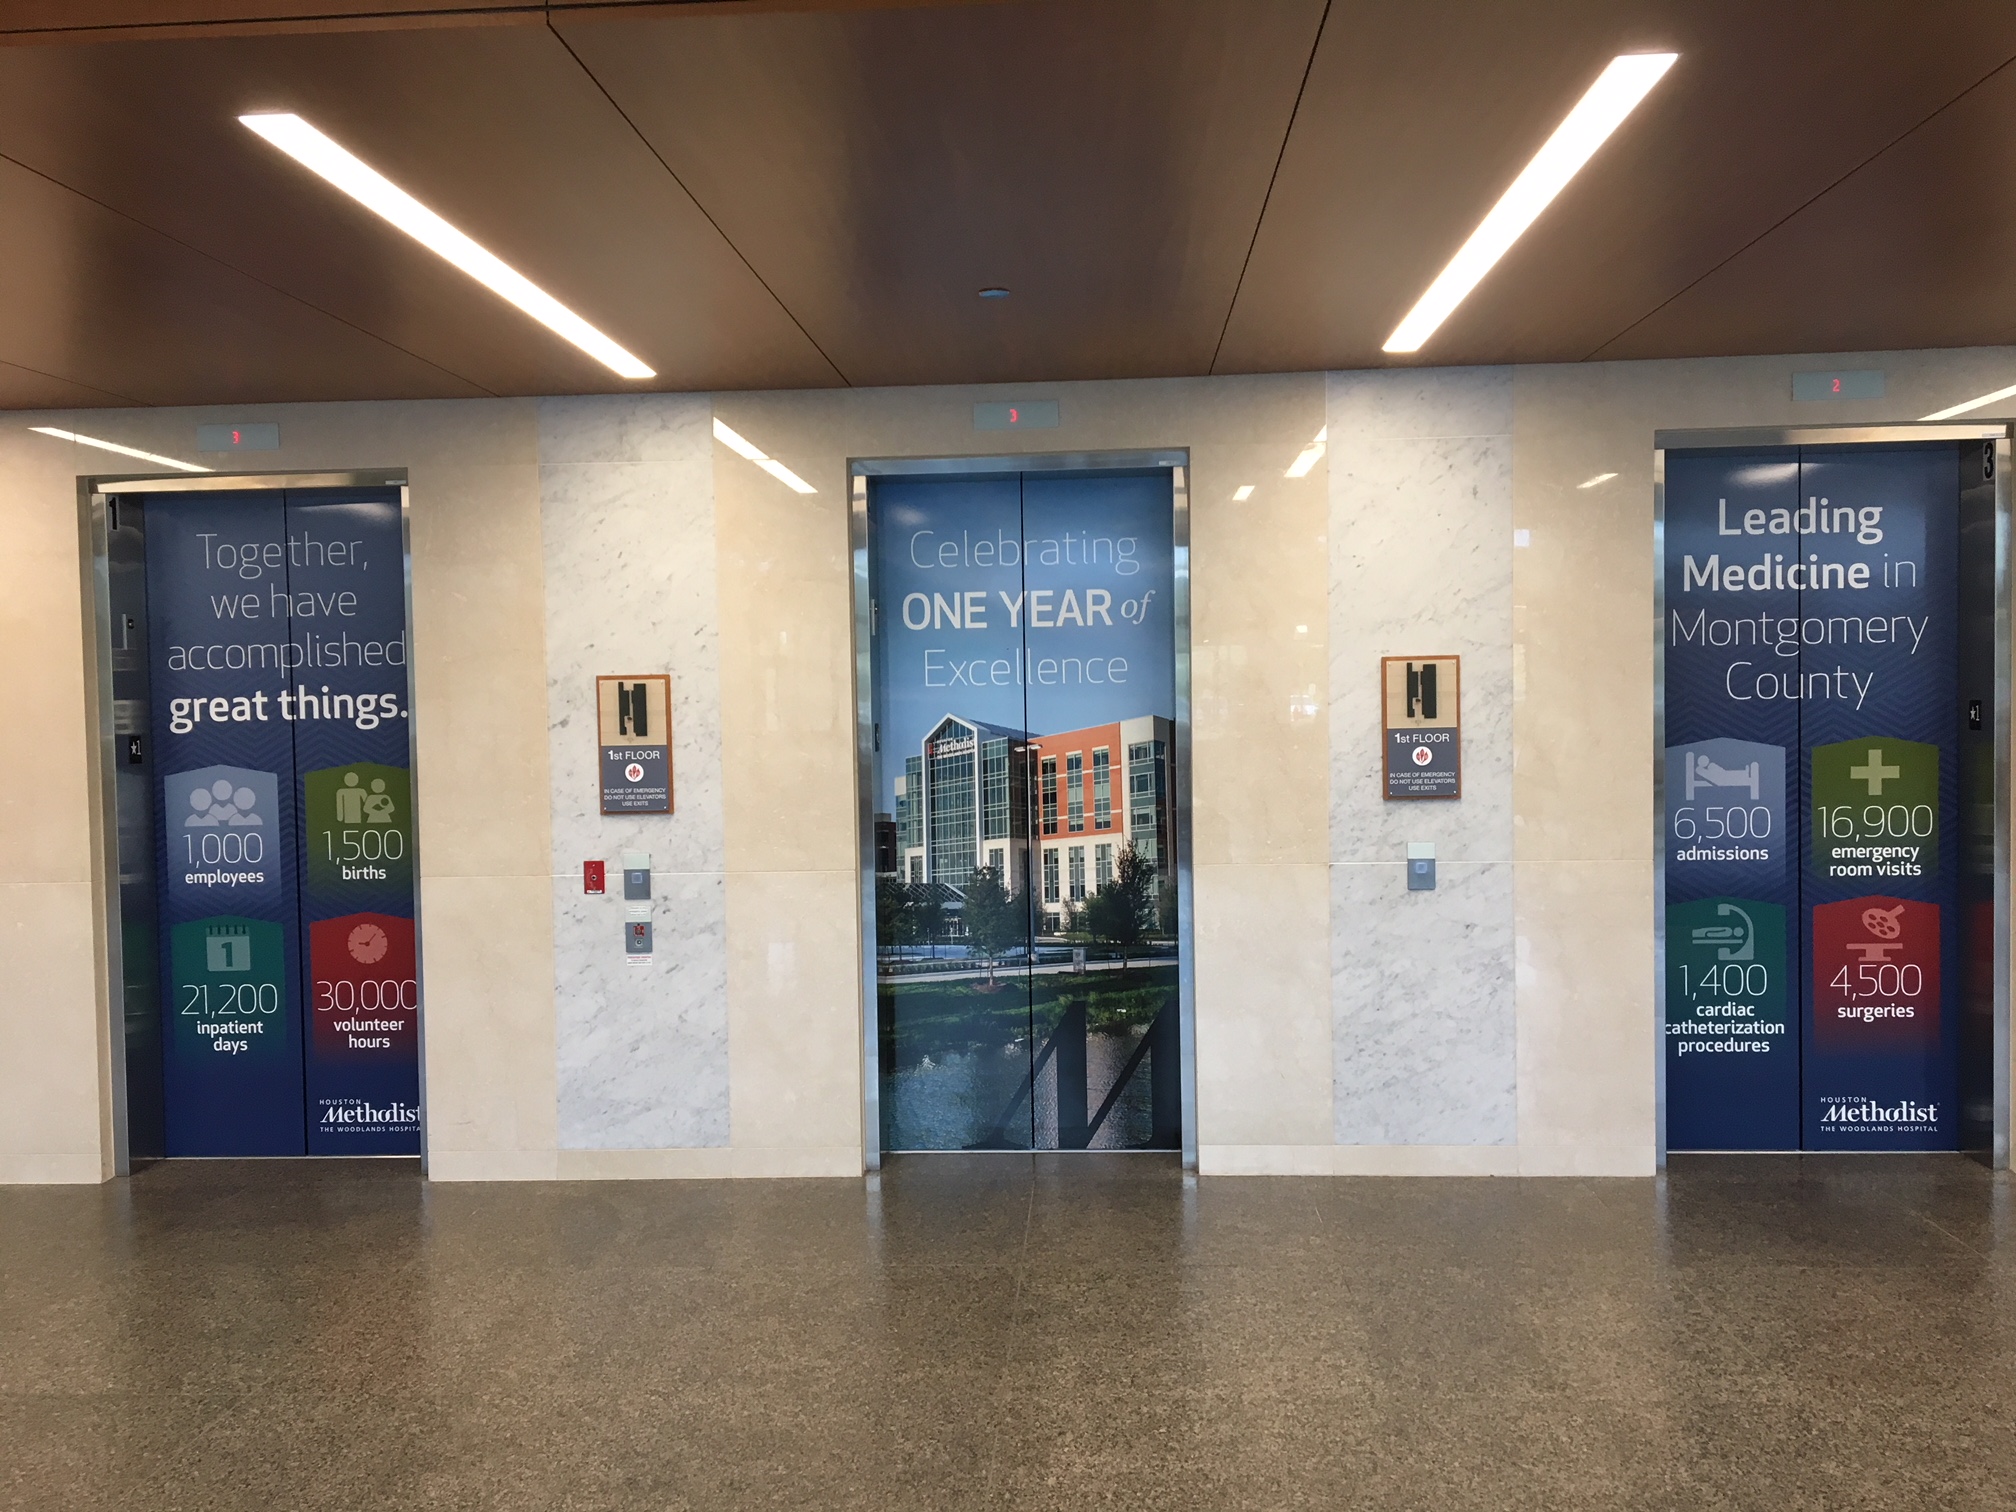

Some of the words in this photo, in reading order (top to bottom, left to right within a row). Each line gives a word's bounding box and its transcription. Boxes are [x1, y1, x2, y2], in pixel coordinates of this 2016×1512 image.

[1832, 378, 1841, 392] 2
[1010, 408, 1019, 423] 3
[231, 430, 240, 444] 3
[1984, 442, 1993, 479] 3
[109, 497, 118, 531] 1
[1718, 496, 1884, 545] Leading
[196, 531, 368, 580] Together,
[910, 529, 1141, 576] Celebrating
[1683, 553, 1870, 591] Medicine
[1883, 553, 1917, 588] in
[211, 594, 260, 619] we
[270, 583, 357, 617] have
[902, 591, 988, 631] ONE
[998, 589, 1113, 628] YEAR
[1120, 589, 1156, 625] of
[1671, 608, 1929, 657] Montgomery
[167, 630, 406, 679] accomplished
[924, 647, 1129, 688] Excellence
[1726, 661, 1874, 711] County
[169, 691, 269, 734] great
[277, 685, 408, 730] things.
[937, 736, 975, 754] Methodis
[1394, 732, 1410, 744] 1st
[1412, 733, 1450, 743] FLOOR
[608, 749, 623, 760] 1st
[625, 750, 660, 760] FLOOR
[1674, 806, 1771, 843] 6,500
[1817, 804, 1933, 842] 16,900
[183, 832, 263, 868] 1,000
[322, 829, 403, 865] 1,500
[1676, 847, 1769, 861] admissions
[1831, 845, 1920, 862] emergency
[185, 870, 265, 887] employees
[342, 865, 387, 881] births
[1829, 864, 1872, 877] room
[1876, 861, 1922, 876] visits
[221, 941, 233, 968] 1
[1679, 963, 1768, 1001] 1,400
[1829, 964, 1923, 1001] 4,500
[181, 983, 278, 1018] 21,200
[317, 979, 418, 1015] 30,000
[1696, 1001, 1755, 1017] cardiac
[333, 1016, 405, 1032] volunteer
[1837, 1003, 1915, 1022] surgeries
[196, 1019, 264, 1039] inpatient
[1665, 1019, 1785, 1035] catheterization
[213, 1036, 248, 1055] days
[348, 1033, 391, 1049] hours
[1678, 1037, 1770, 1057] procedures
[320, 1102, 420, 1123] Methodist
[1820, 1100, 1939, 1122] Methodist
